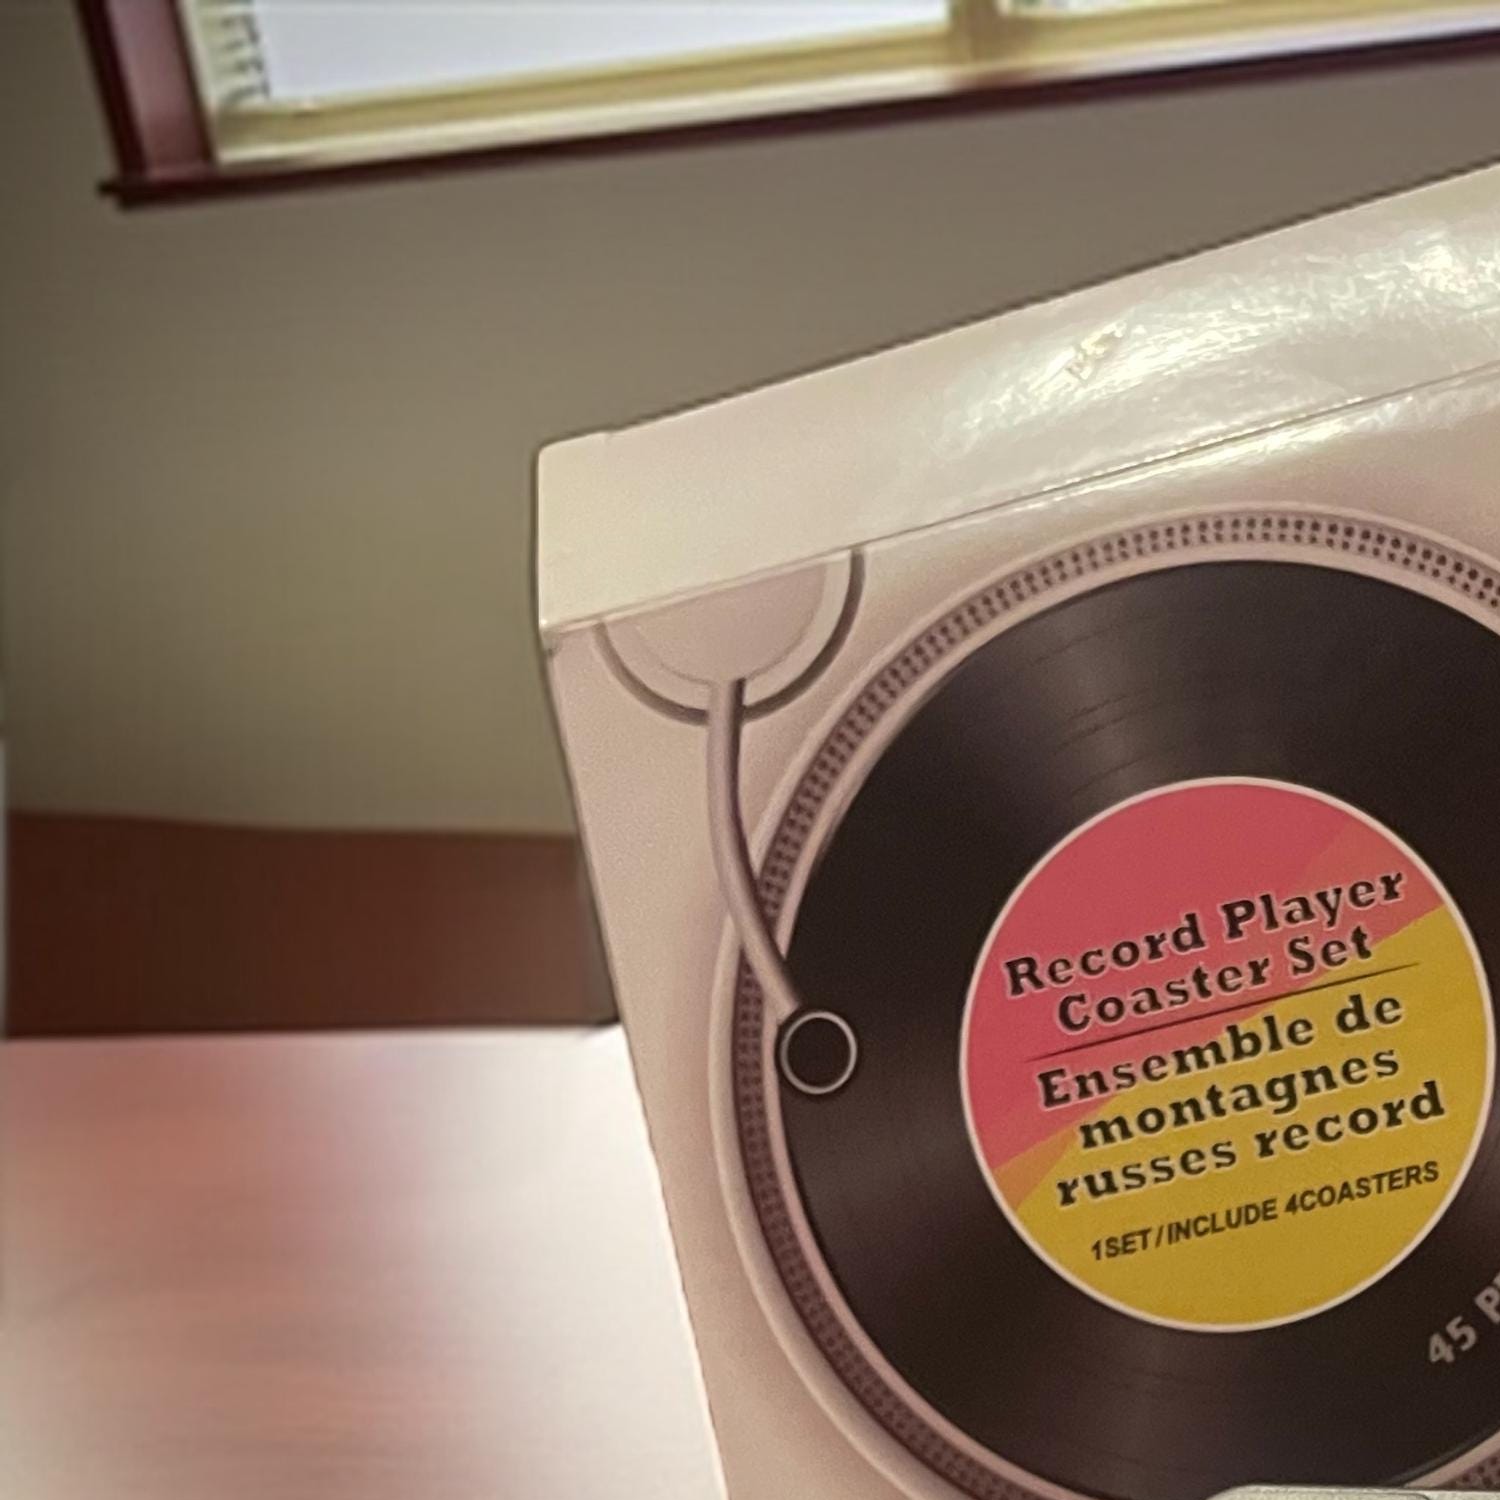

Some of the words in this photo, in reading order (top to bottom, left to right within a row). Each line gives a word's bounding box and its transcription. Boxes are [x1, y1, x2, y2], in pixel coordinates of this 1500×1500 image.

[1005, 913, 1206, 996] Record
[1221, 872, 1403, 938] Player
[1058, 957, 1271, 1032] Coaster
[1288, 926, 1372, 976] Set
[1038, 1015, 1314, 1107] Ensemble
[1336, 994, 1402, 1034] de
[1080, 1049, 1400, 1149] montagnes
[1056, 1140, 1236, 1206] russes
[1256, 1080, 1445, 1158] record
[1284, 1161, 1439, 1216] 4COASTERS
[1429, 1316, 1477, 1363] 45
